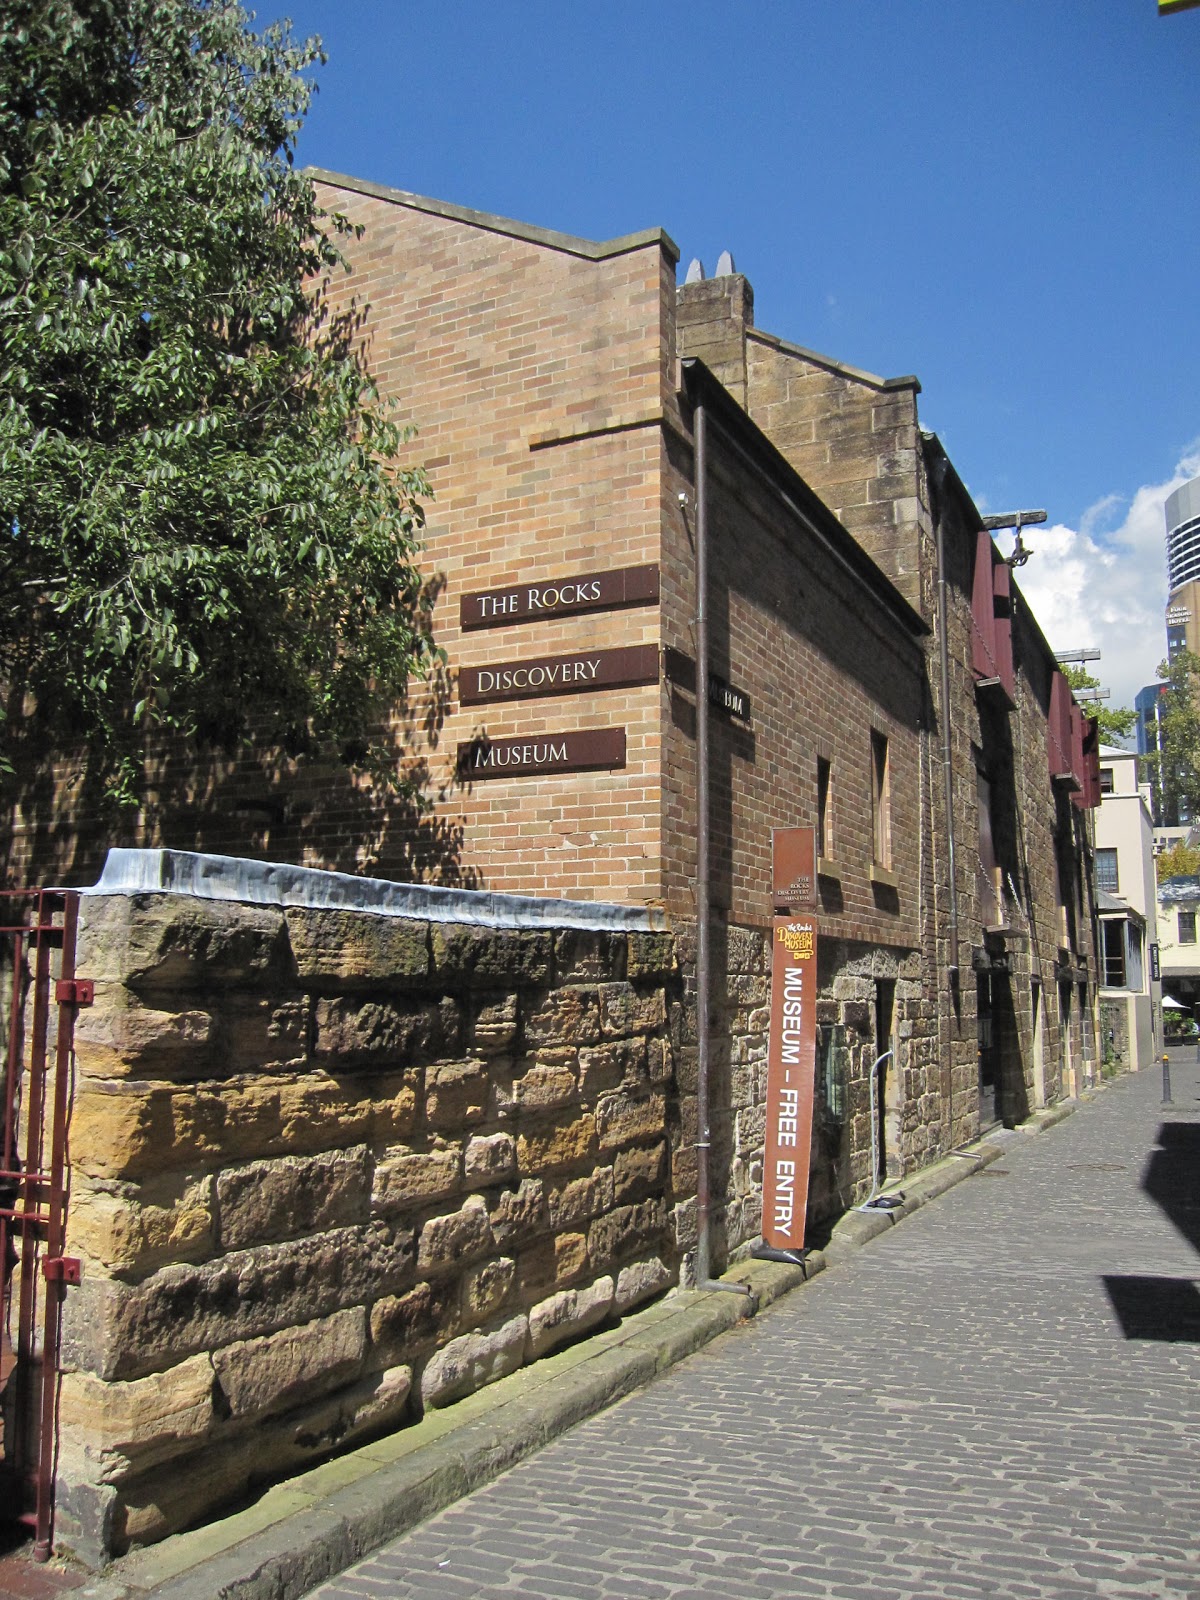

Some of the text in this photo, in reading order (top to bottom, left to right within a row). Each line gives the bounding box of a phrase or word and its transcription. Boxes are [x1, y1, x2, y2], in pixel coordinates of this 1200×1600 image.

[476, 581, 601, 618] THE ROCKS
[477, 659, 601, 692] DISCOVERY
[474, 742, 569, 768] MUSEUM
[784, 940, 813, 950] MUSEUM
[781, 967, 802, 1064] MUSEUM
[777, 1088, 799, 1147] FREE
[773, 1160, 796, 1237] ENTRY
